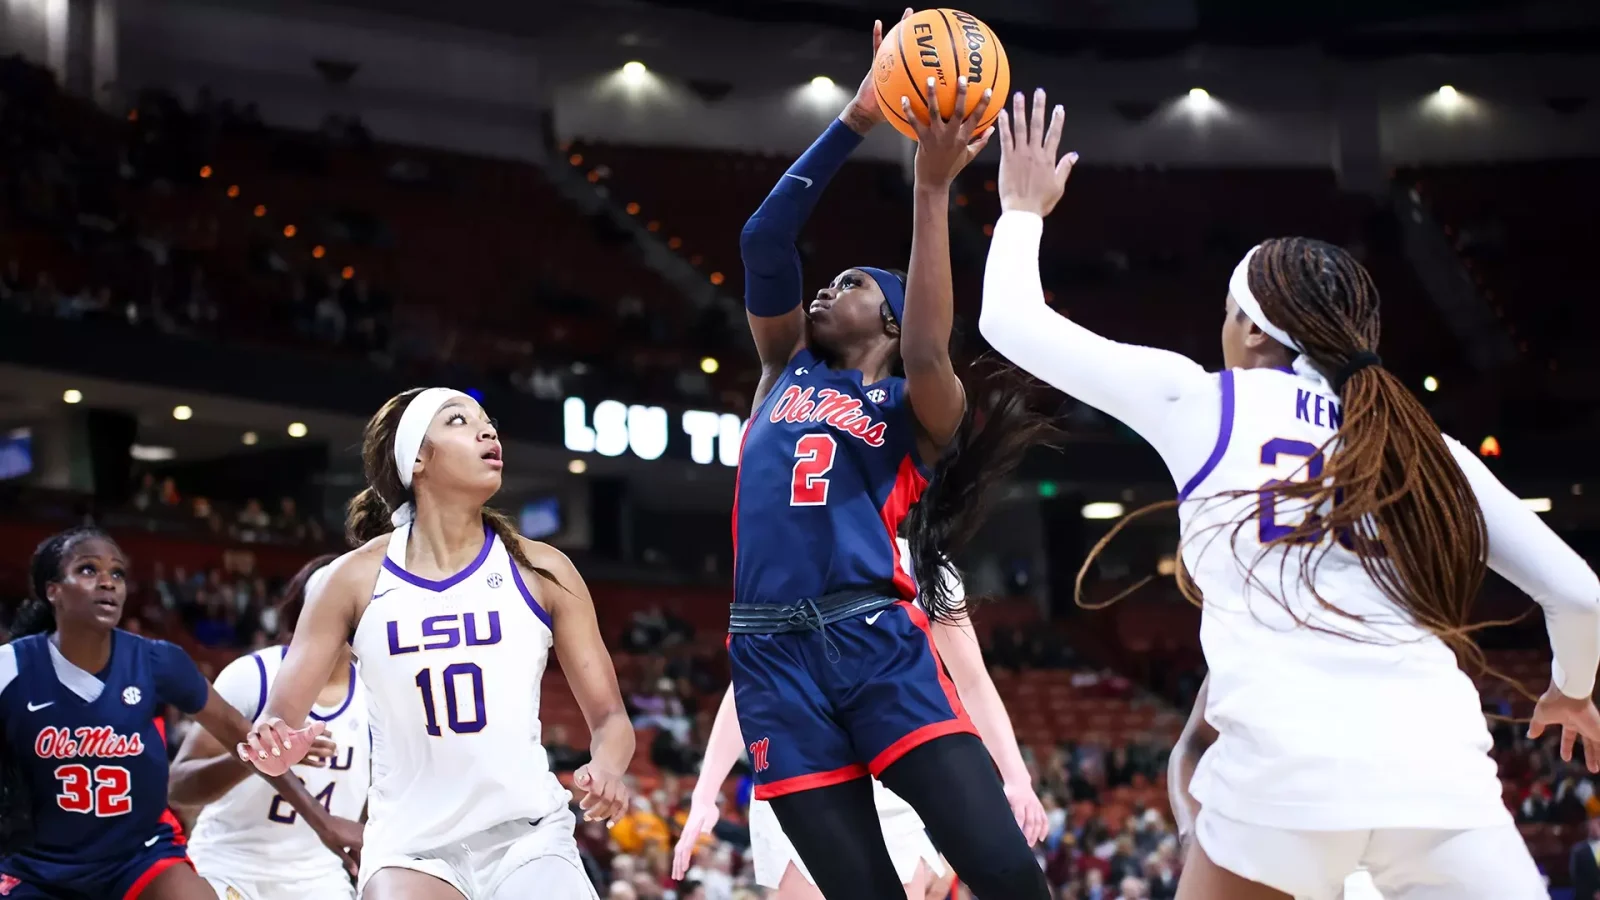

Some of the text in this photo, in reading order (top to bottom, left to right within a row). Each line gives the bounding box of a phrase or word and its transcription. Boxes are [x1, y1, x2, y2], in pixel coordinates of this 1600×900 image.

[952, 11, 985, 83] Wilson
[769, 384, 887, 447] Ole Miss
[866, 388, 888, 404] SEC
[563, 396, 750, 467] LSU TI
[790, 434, 837, 506] 2
[386, 610, 502, 656] LSU
[415, 662, 487, 737] 10
[35, 725, 144, 759] Ole Miss
[54, 763, 132, 818] 32
